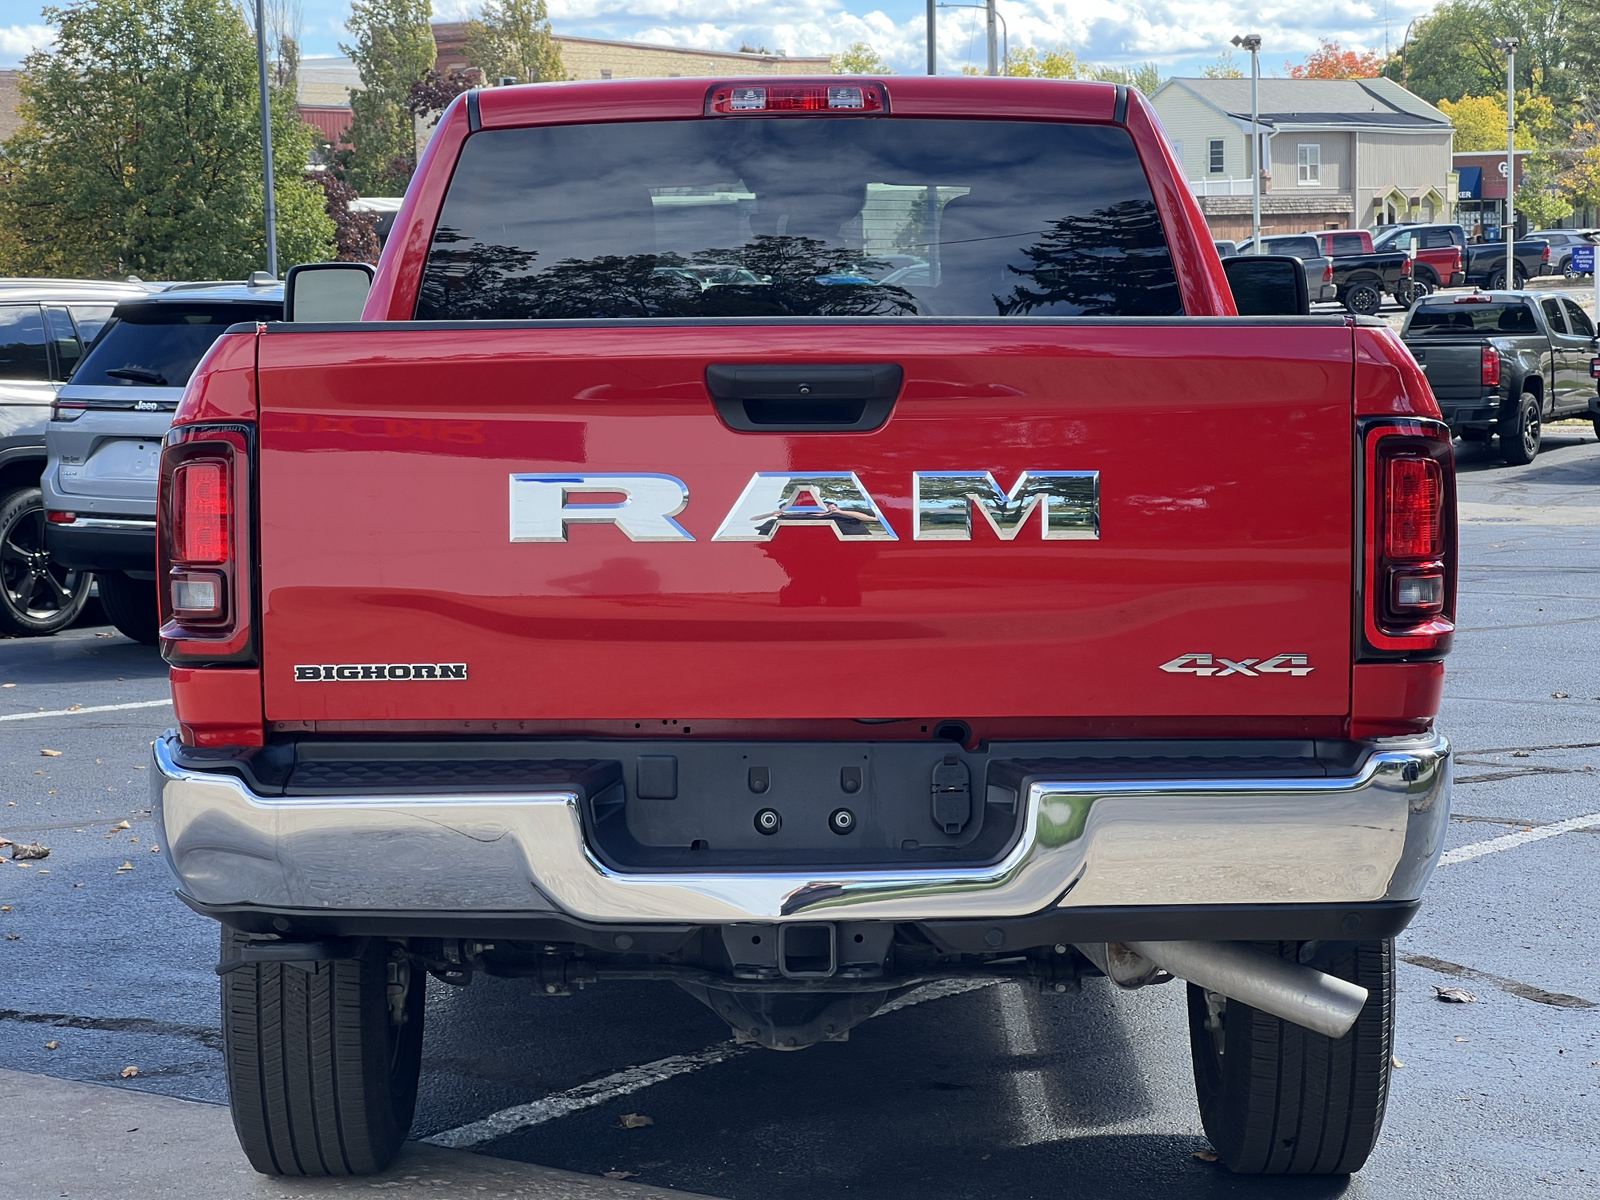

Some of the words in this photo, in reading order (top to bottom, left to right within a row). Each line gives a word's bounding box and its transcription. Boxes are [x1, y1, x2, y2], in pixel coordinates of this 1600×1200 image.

[134, 400, 158, 412] Jeep
[508, 471, 1101, 543] RAM
[294, 663, 468, 682] BIGHORN
[1158, 653, 1316, 677] 4x4
